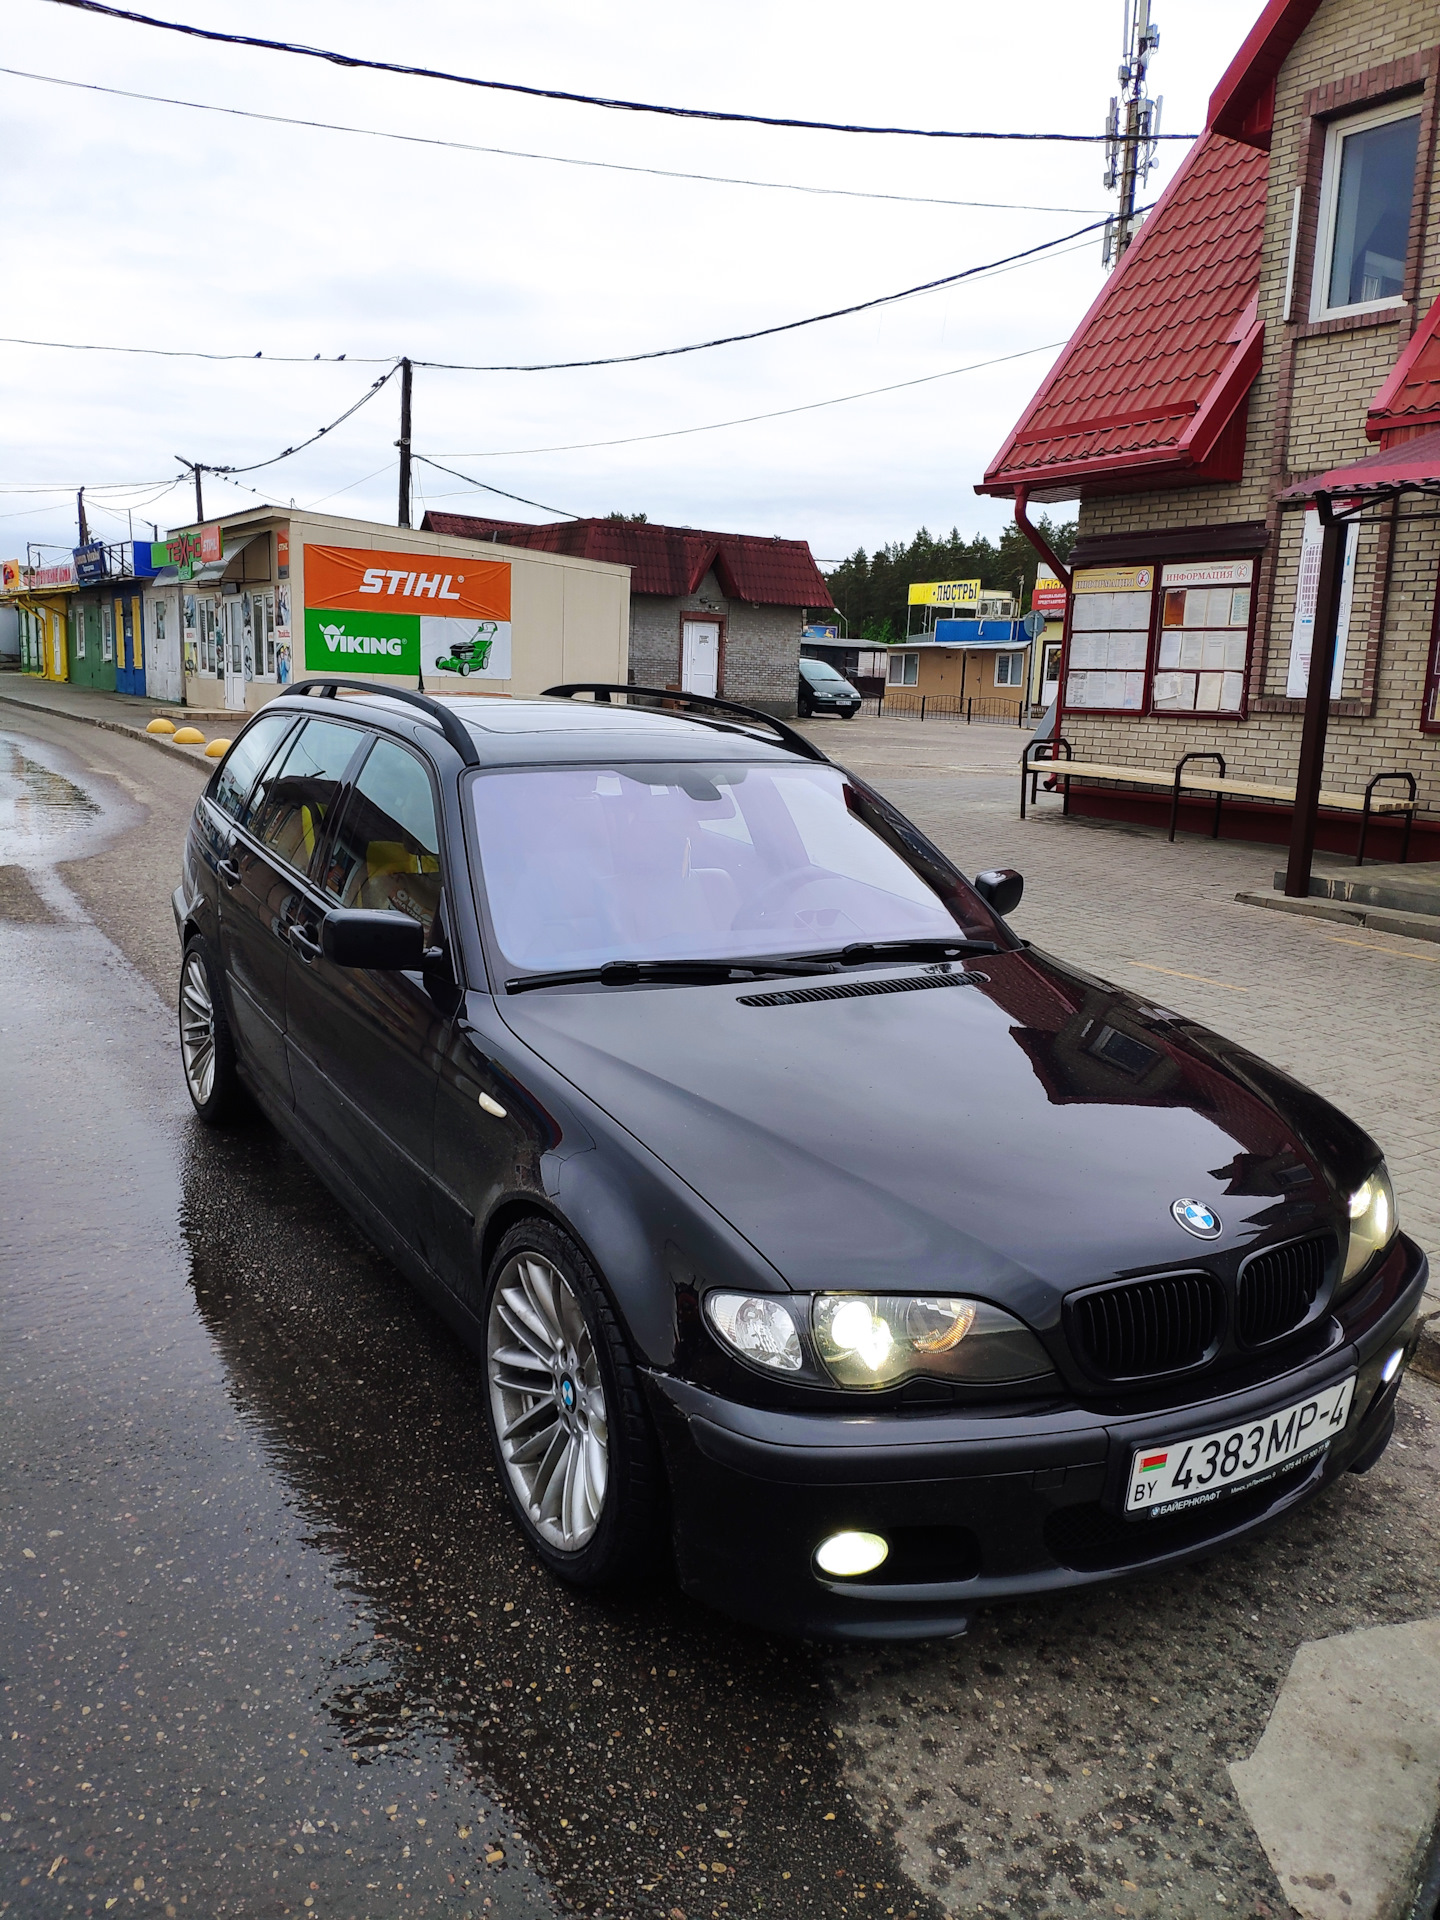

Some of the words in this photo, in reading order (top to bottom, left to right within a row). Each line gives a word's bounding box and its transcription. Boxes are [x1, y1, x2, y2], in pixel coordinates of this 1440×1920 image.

[359, 568, 461, 600] STIHL
[1075, 578, 1134, 590] ИНФОРМАЦИЯ
[1165, 570, 1233, 582] ИНФОРМАЦИЯ
[937, 583, 978, 601] ЛЮСТРЫ
[323, 634, 402, 656] VIKING
[1171, 1386, 1347, 1490] 4383MP-4
[1133, 1480, 1158, 1502] BY
[1160, 1490, 1222, 1514] БАЙЕРНКРАФТ
